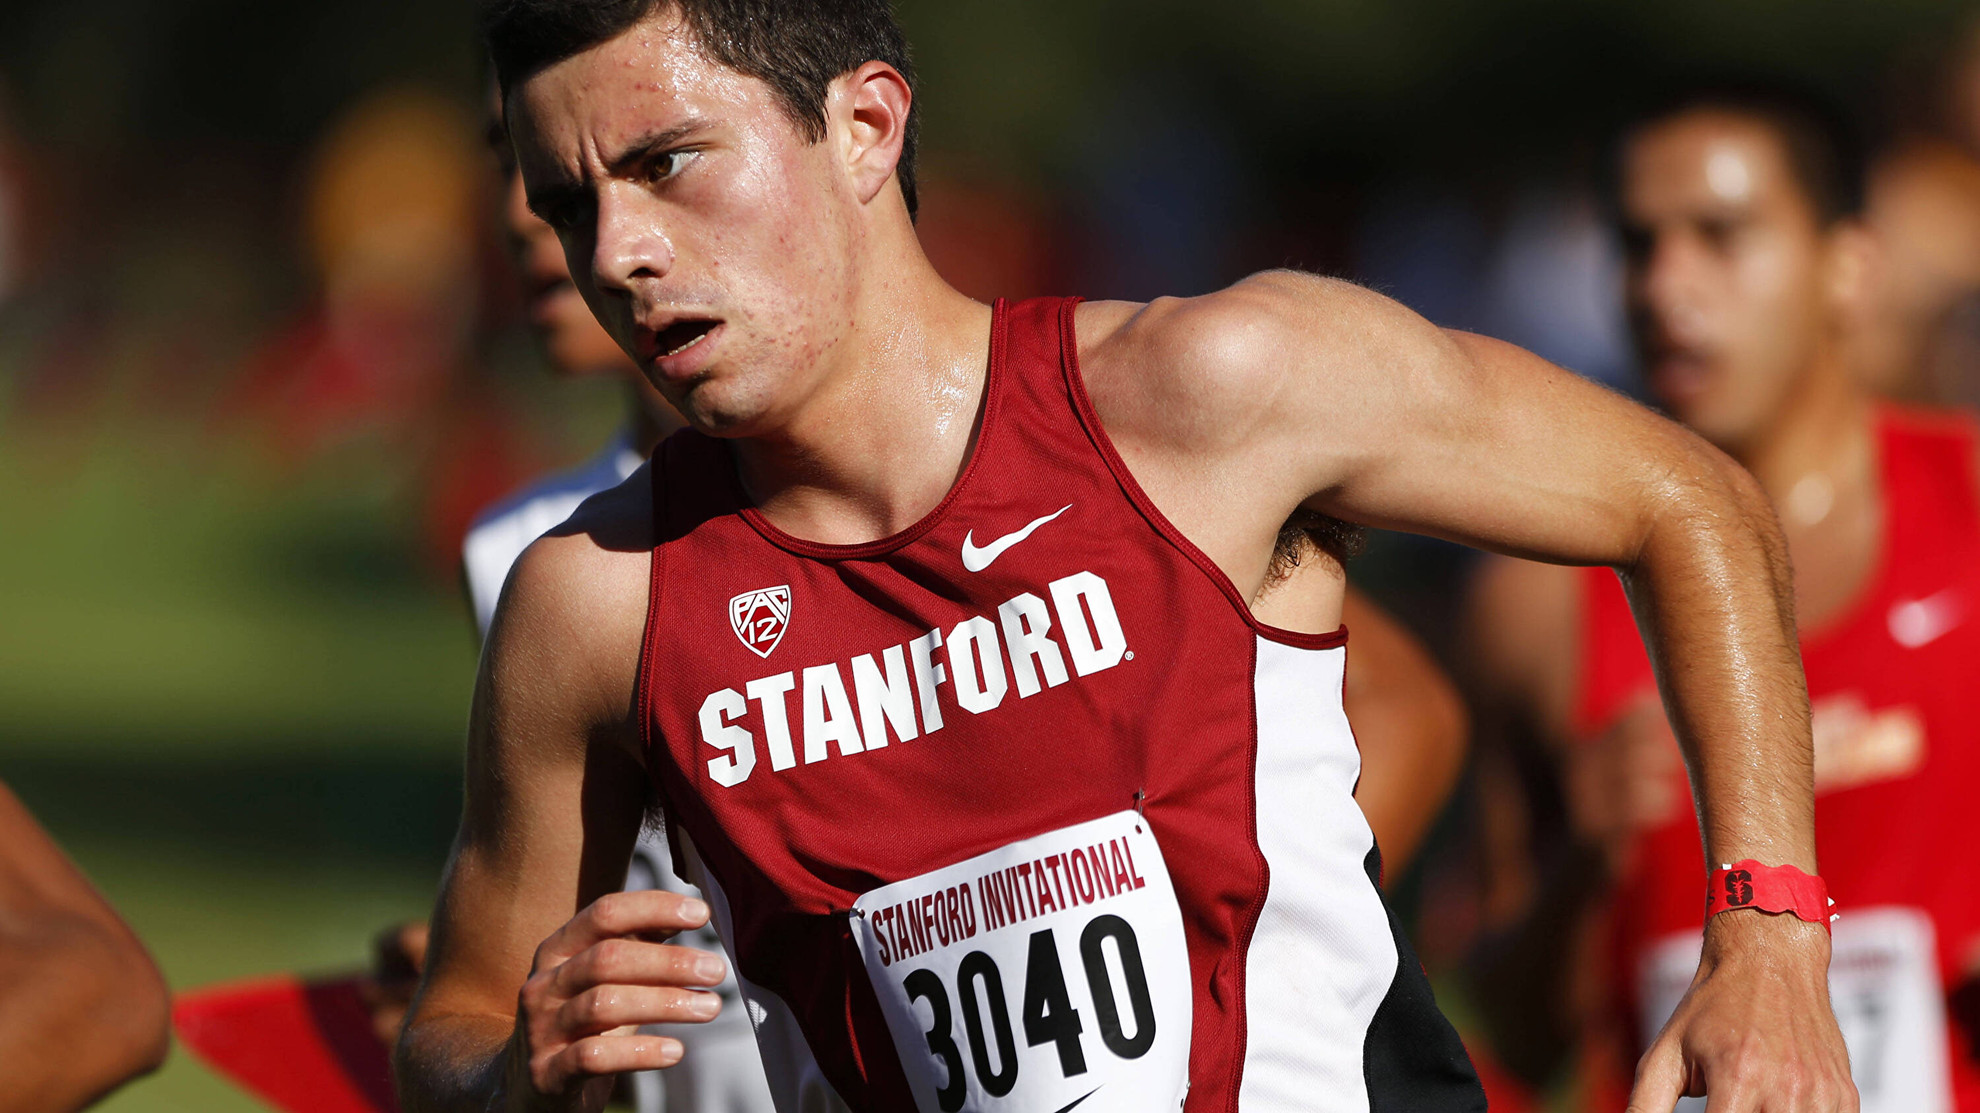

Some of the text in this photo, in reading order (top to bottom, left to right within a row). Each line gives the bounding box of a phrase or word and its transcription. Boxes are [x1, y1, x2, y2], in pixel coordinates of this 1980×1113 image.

[734, 588, 788, 634] PAC
[748, 617, 779, 645] 12
[698, 571, 1128, 788] STANFORD
[871, 836, 1145, 967] STANFORD INVITATIONAL
[902, 914, 1156, 1113] 3040
